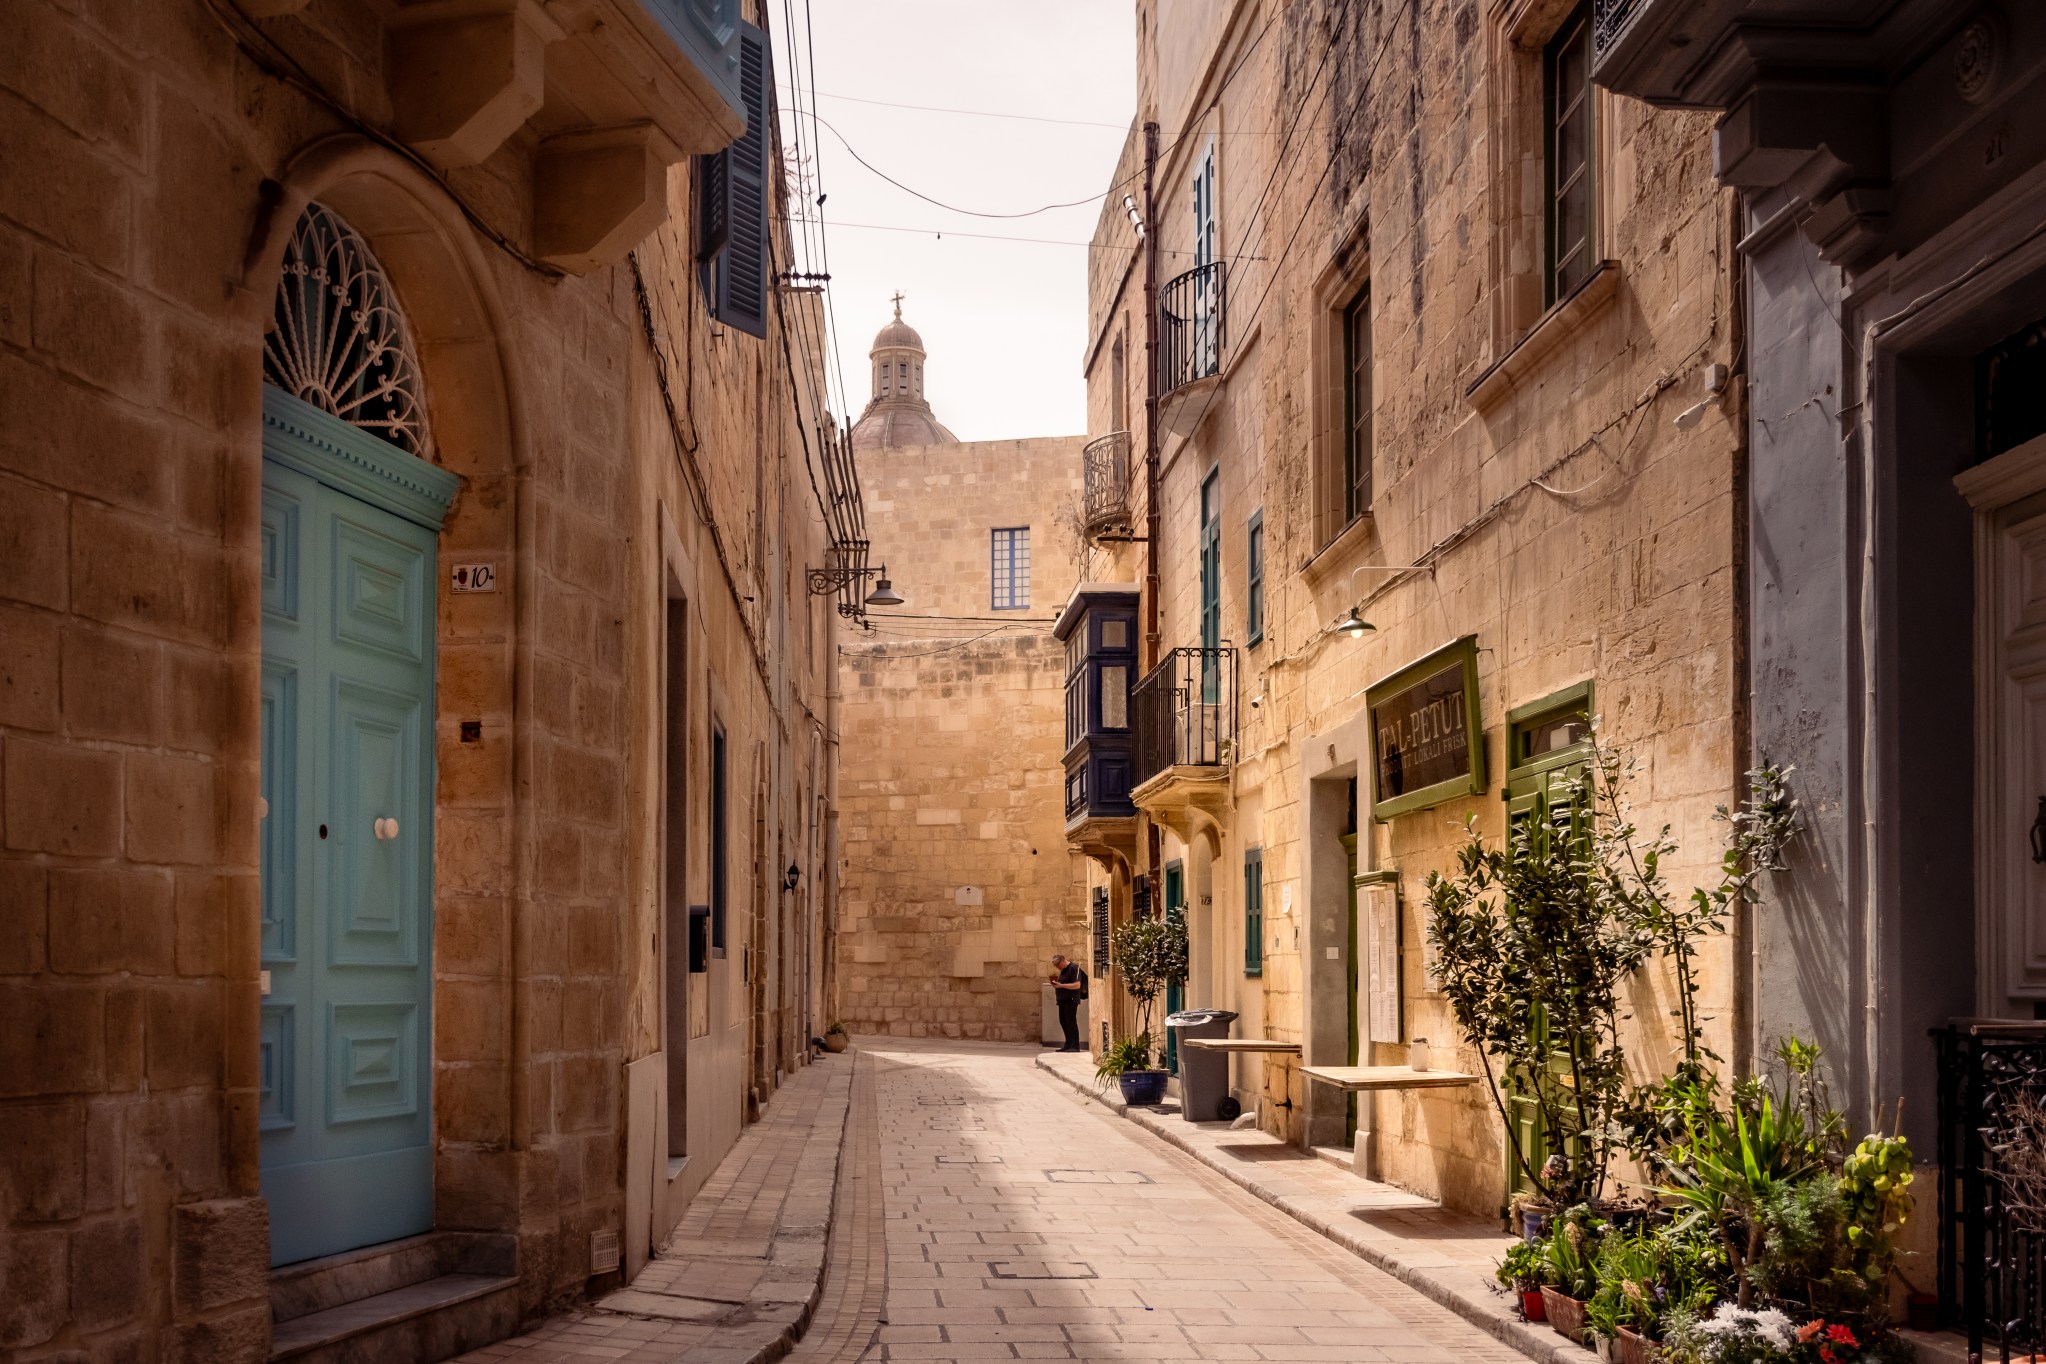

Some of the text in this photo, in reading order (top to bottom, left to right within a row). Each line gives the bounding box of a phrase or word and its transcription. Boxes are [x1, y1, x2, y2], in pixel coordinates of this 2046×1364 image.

[471, 566, 489, 588] 10
[1380, 690, 1464, 760] TAL-PETUT
[1414, 742, 1441, 765] LOKALI
[1443, 731, 1467, 754] FRISK
